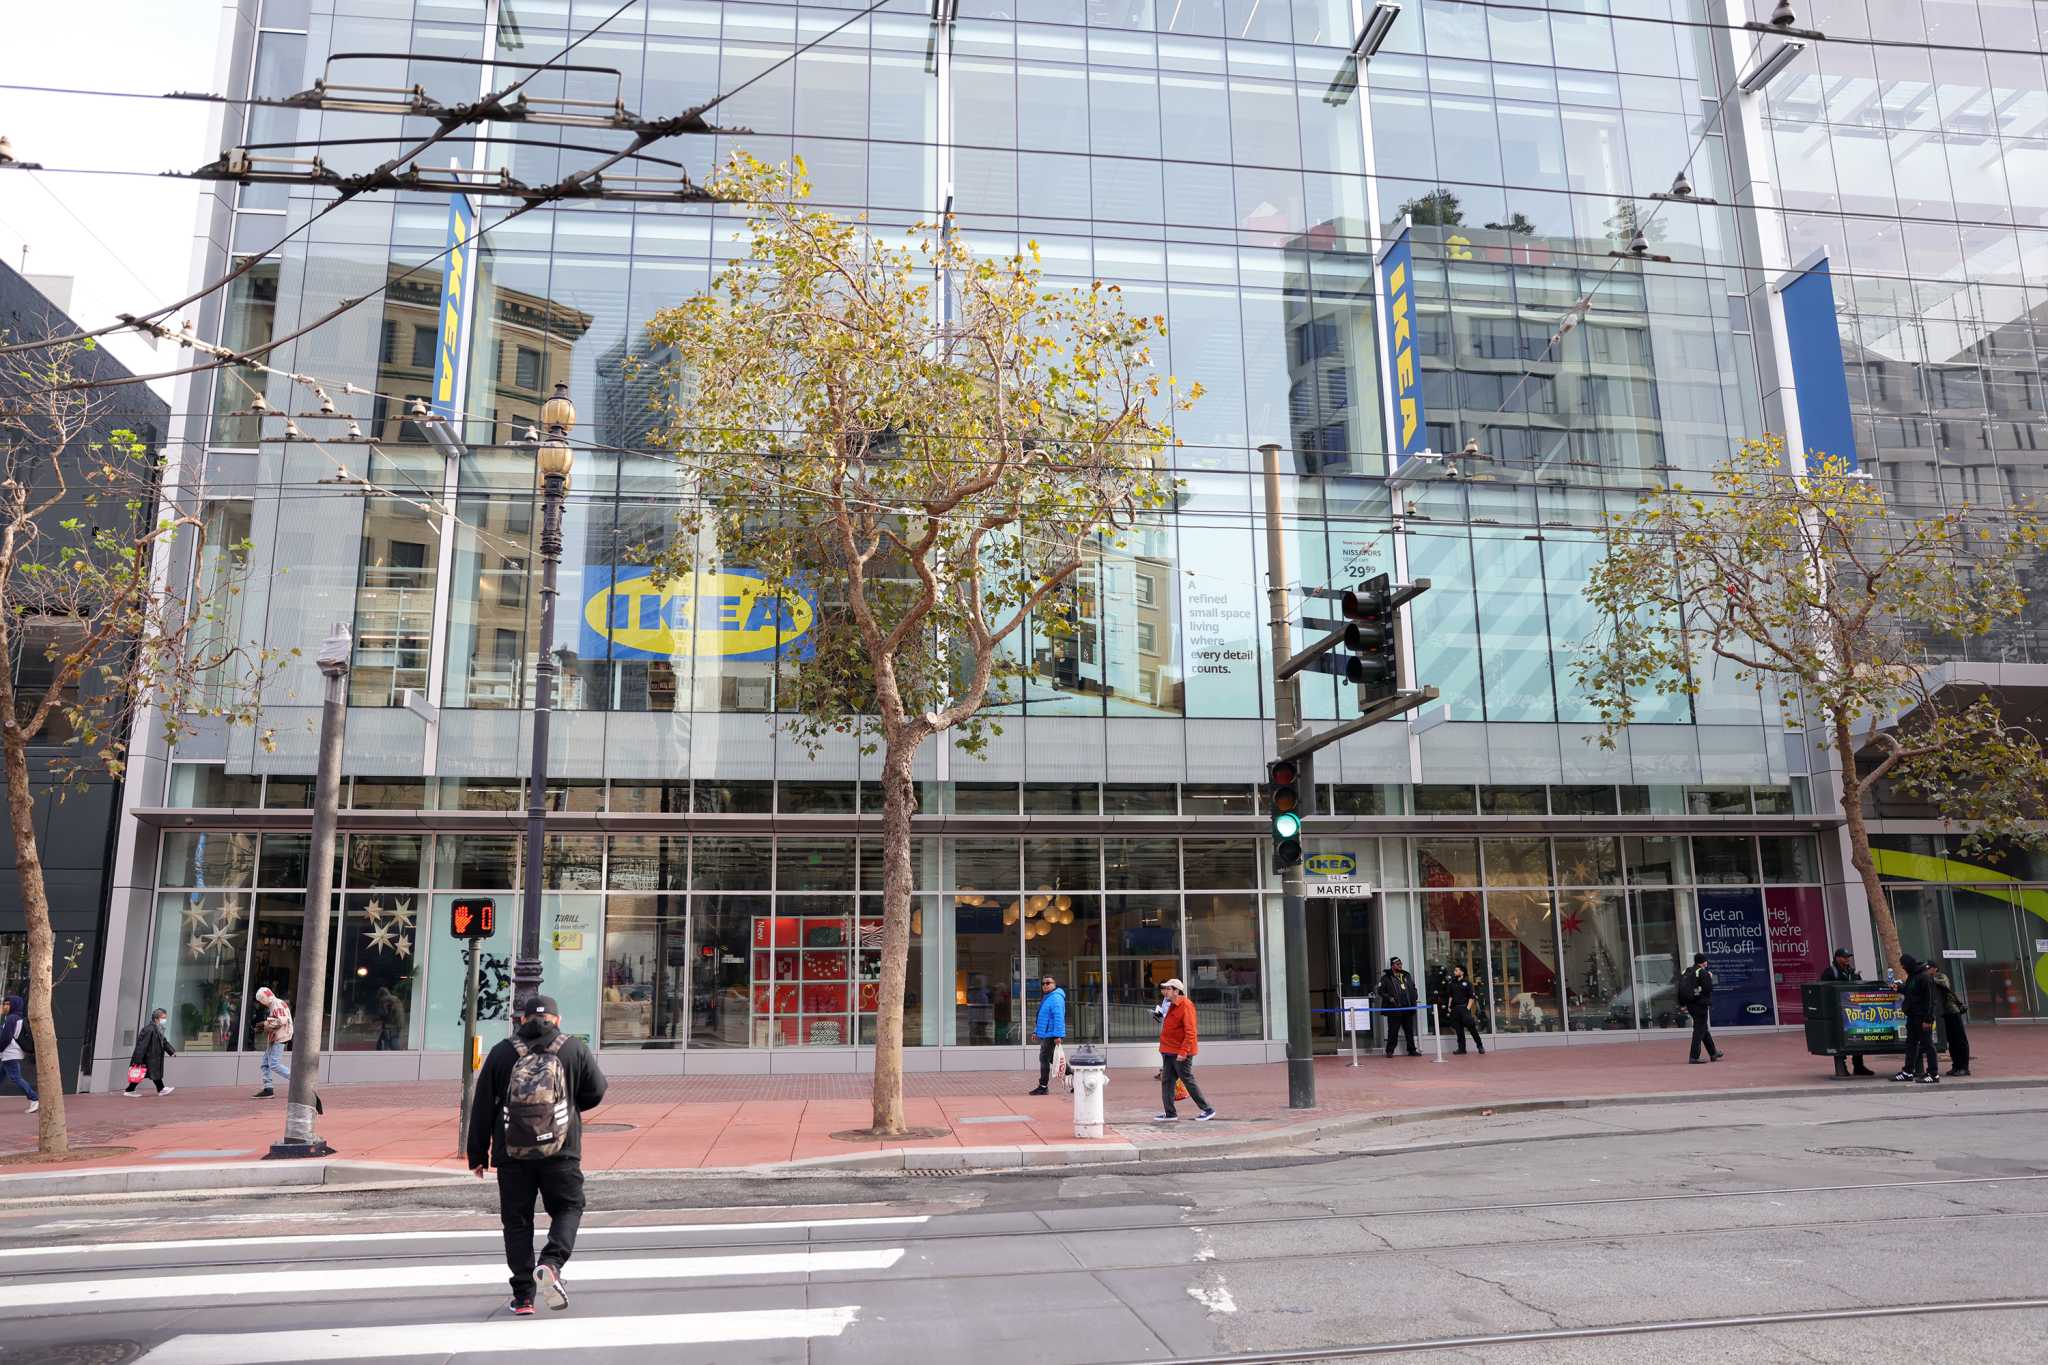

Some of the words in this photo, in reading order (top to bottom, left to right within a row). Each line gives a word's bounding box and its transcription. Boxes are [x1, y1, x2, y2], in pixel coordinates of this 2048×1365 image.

[439, 209, 465, 402] IKEA
[1390, 262, 1418, 450] IKEA
[1188, 581, 1196, 589] A
[1189, 593, 1228, 604] refined
[606, 594, 797, 633] IKEA
[1190, 608, 1218, 618] small
[1220, 610, 1251, 621] space
[1190, 622, 1220, 633] living
[1191, 636, 1225, 646] where
[1191, 651, 1221, 662] every
[1223, 650, 1253, 660] detail
[1192, 664, 1231, 674] counts.
[1309, 860, 1351, 869] IKEA
[1317, 885, 1362, 895] MARKET
[481, 906, 492, 930] 0
[1703, 908, 1725, 921] Get
[1728, 910, 1744, 920] an
[1768, 906, 1791, 923] Hej,
[1705, 923, 1762, 937] unlimited
[1706, 941, 1731, 954] 15%
[1733, 940, 1755, 954] off!
[1771, 939, 1809, 956] hiring!
[1845, 1008, 1876, 1024] POTTED
